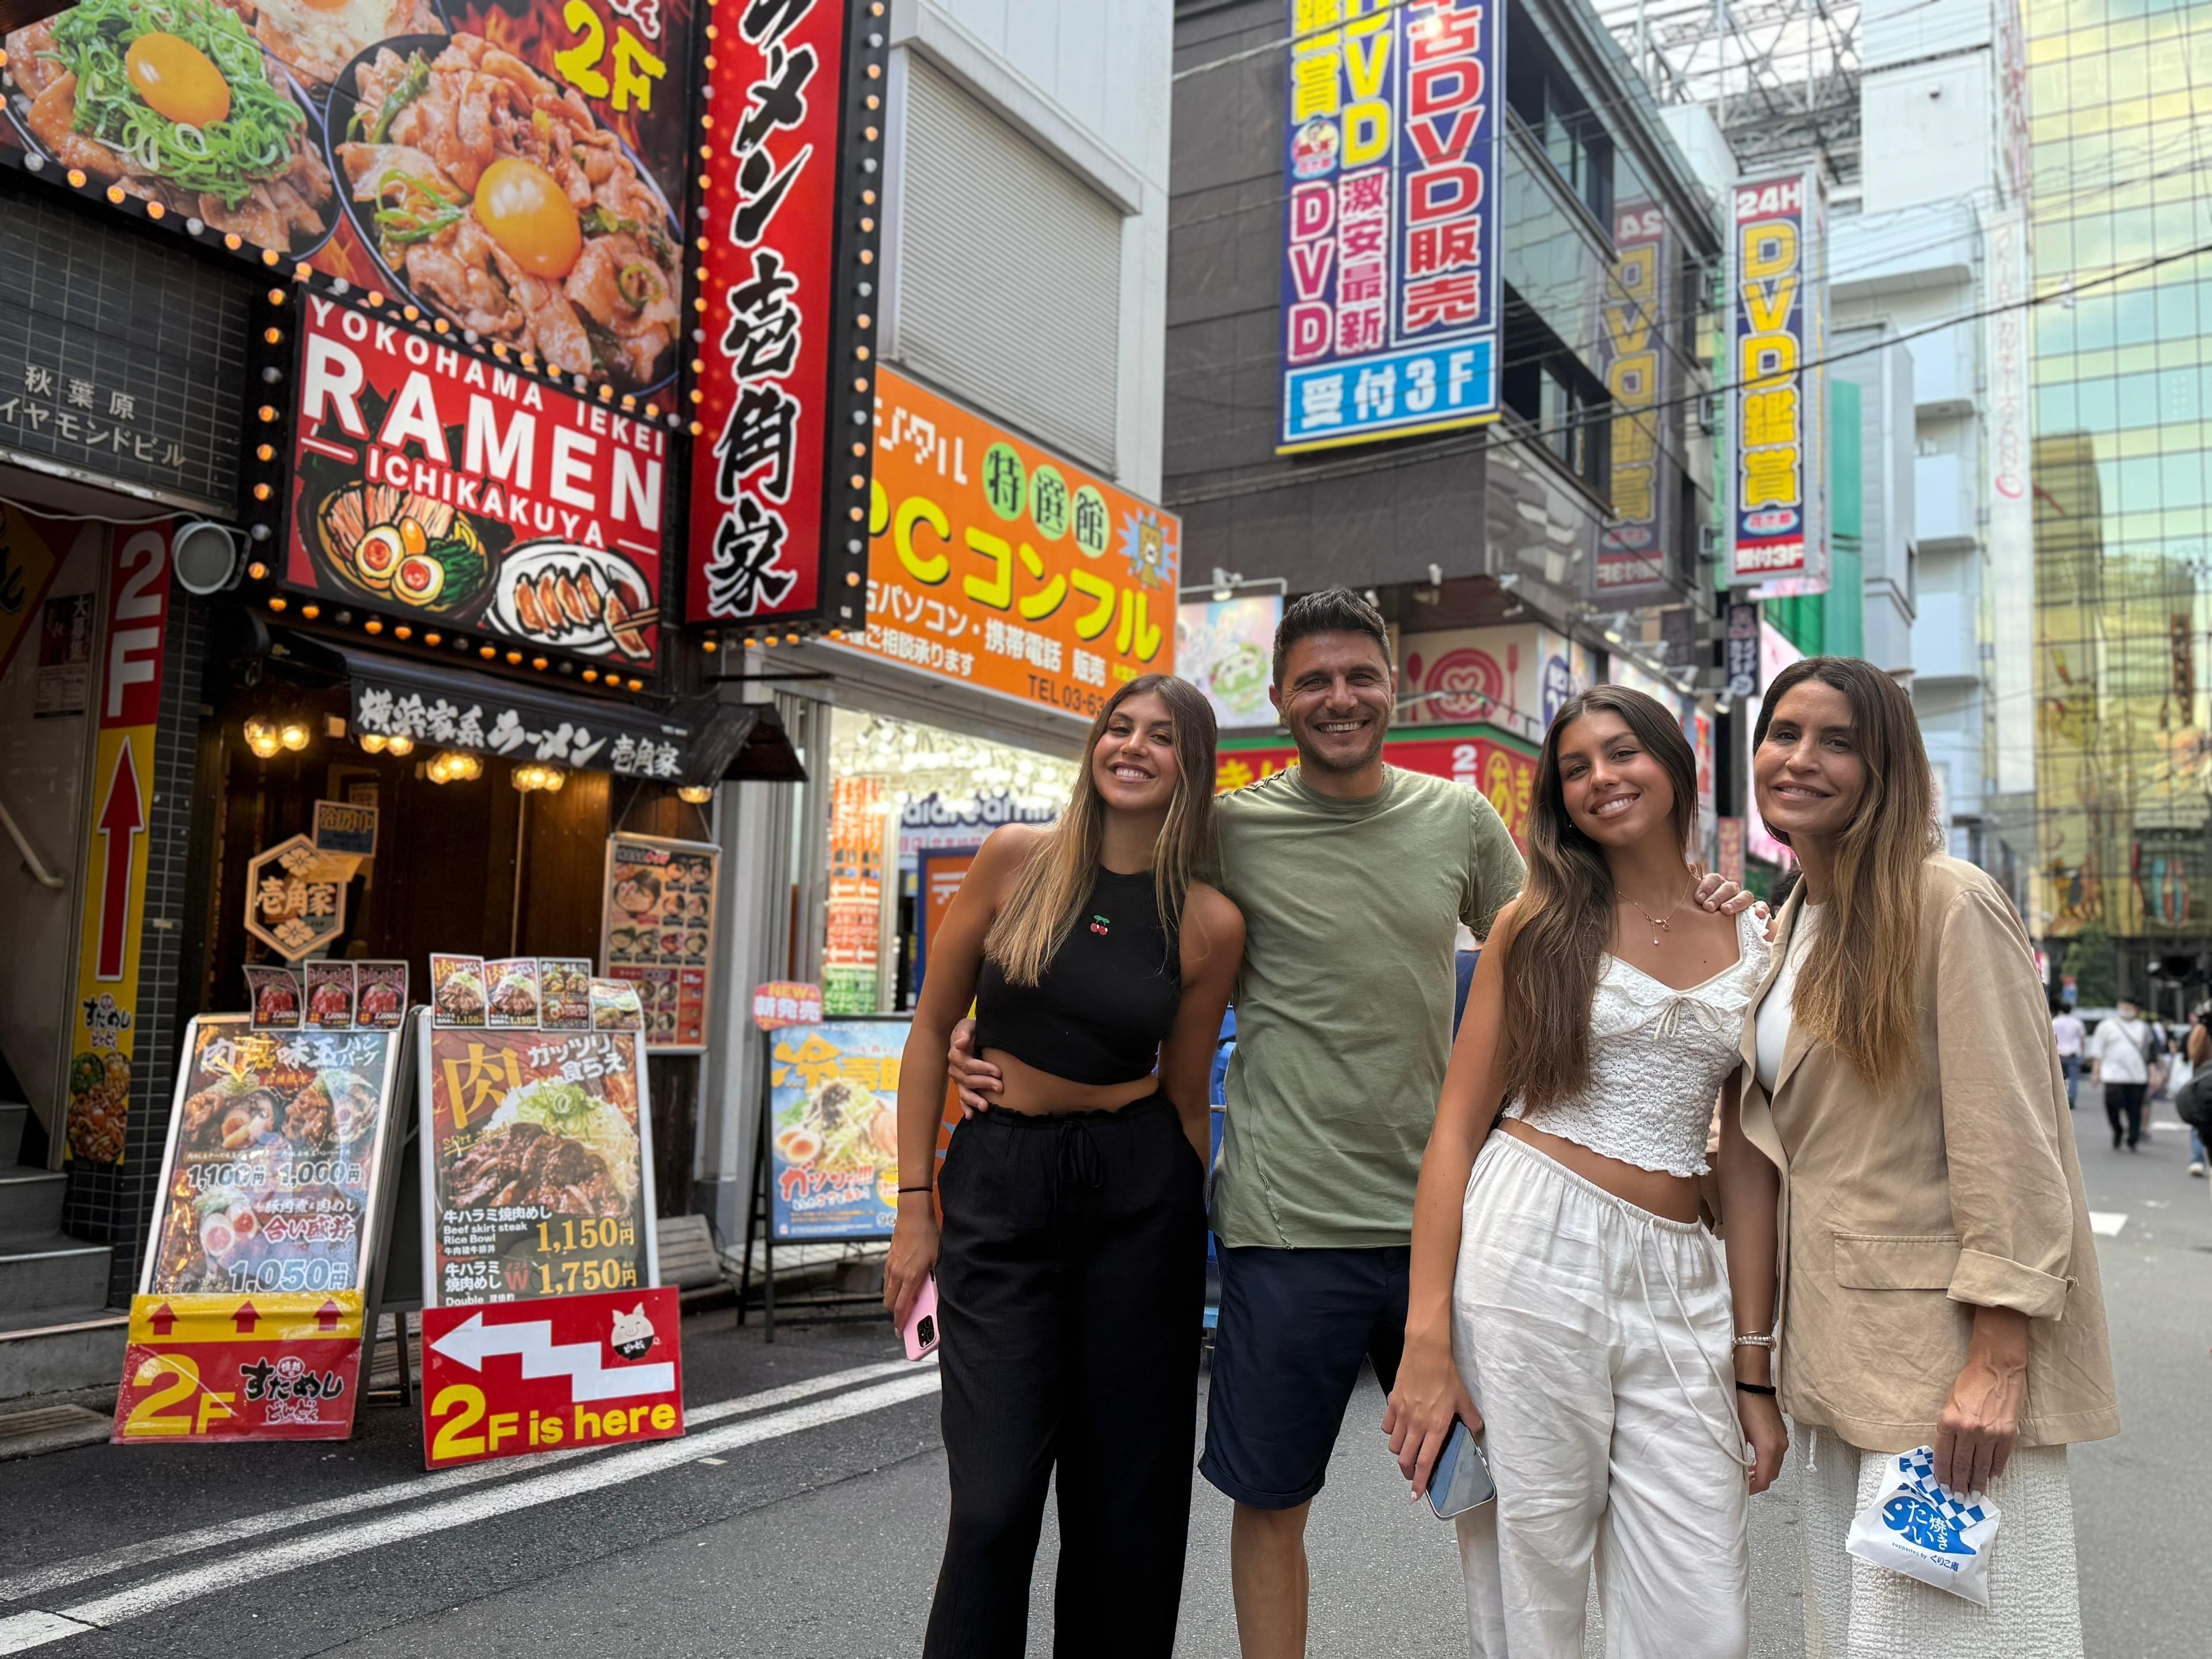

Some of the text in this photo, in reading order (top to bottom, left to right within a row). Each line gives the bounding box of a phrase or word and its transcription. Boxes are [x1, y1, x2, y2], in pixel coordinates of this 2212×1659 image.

[554, 0, 666, 111] 2F
[1406, 0, 1485, 333] 古DVD販売
[1737, 182, 1801, 219] 24H
[1289, 180, 1336, 362] DVD
[25, 364, 135, 421] 秋葉原
[310, 294, 663, 456] YOKOHAMA IEKEI
[303, 332, 662, 532] RAMEN
[368, 448, 604, 548] ICHIKAKUYA
[107, 531, 166, 718] 2F
[1028, 673, 1059, 704] TEL
[358, 687, 682, 778] 横浜家系ラーメン 壱角家
[257, 876, 336, 918] 壱角家
[444, 1043, 522, 1130] 肉
[559, 1052, 626, 1082] 食らえ
[444, 1206, 552, 1225] 牛ハラミ焼肉めし
[444, 1221, 528, 1235] Beef skirt steak
[536, 1217, 635, 1253] 1,150円
[444, 1233, 496, 1245] Rice Bowl
[445, 1260, 500, 1277] 牛ハラミ
[445, 1275, 502, 1293] 焼肉めし
[505, 1269, 530, 1291] W
[539, 1257, 637, 1296] 1,750円
[445, 1295, 484, 1307] Double
[123, 1353, 236, 1437] 2F
[431, 1384, 677, 1461] 2F is here
